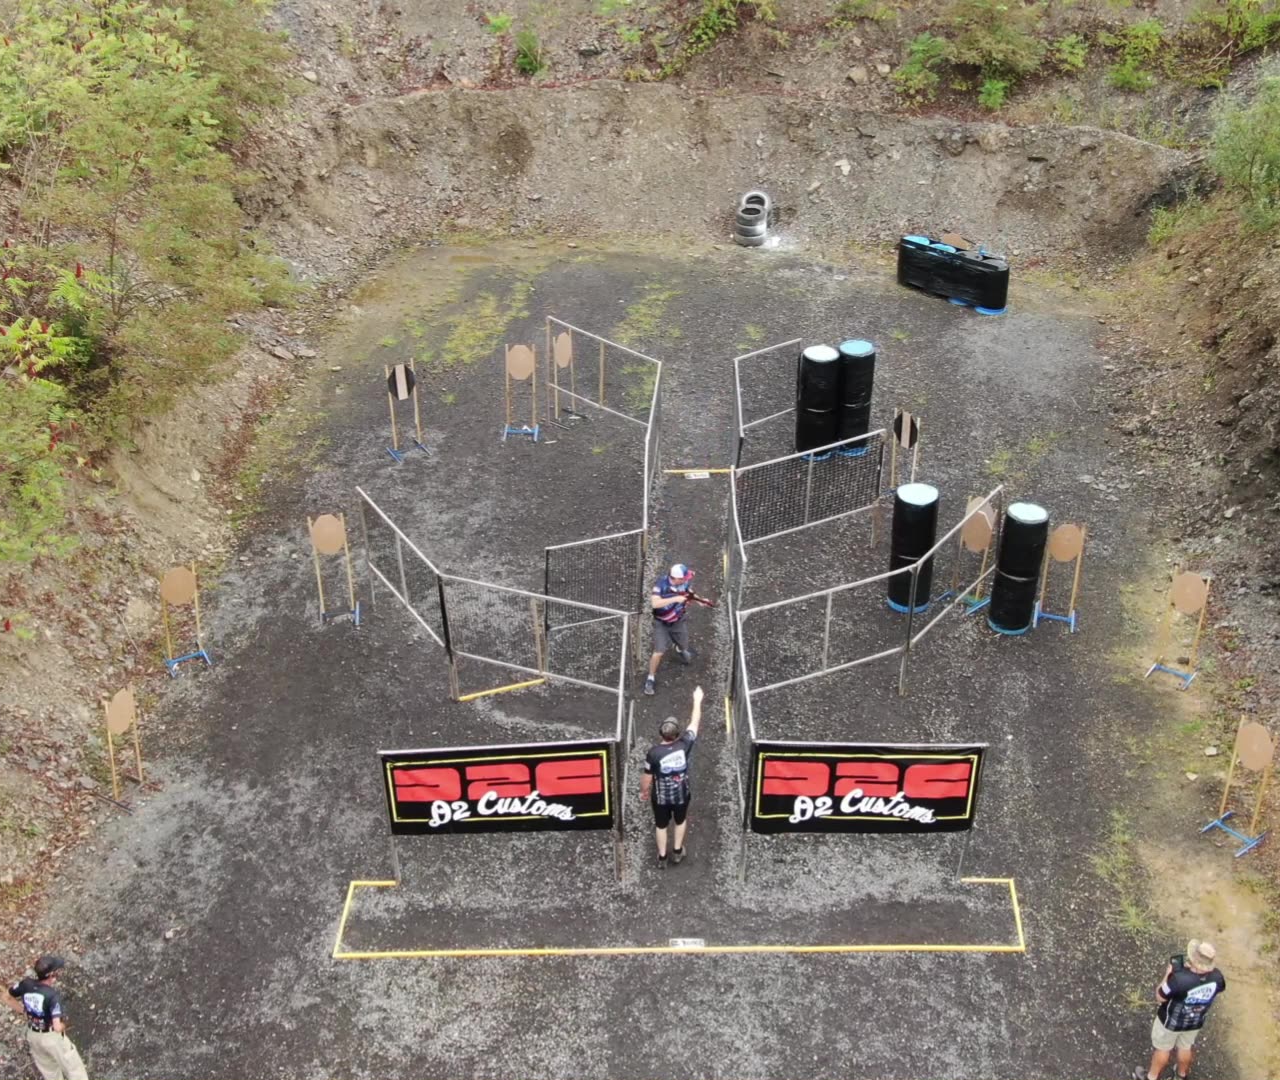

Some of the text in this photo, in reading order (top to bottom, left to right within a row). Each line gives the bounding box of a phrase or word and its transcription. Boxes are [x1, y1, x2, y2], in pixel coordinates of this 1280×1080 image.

[428, 790, 576, 827] D2 Customs
[789, 788, 936, 823] D2 Customs
